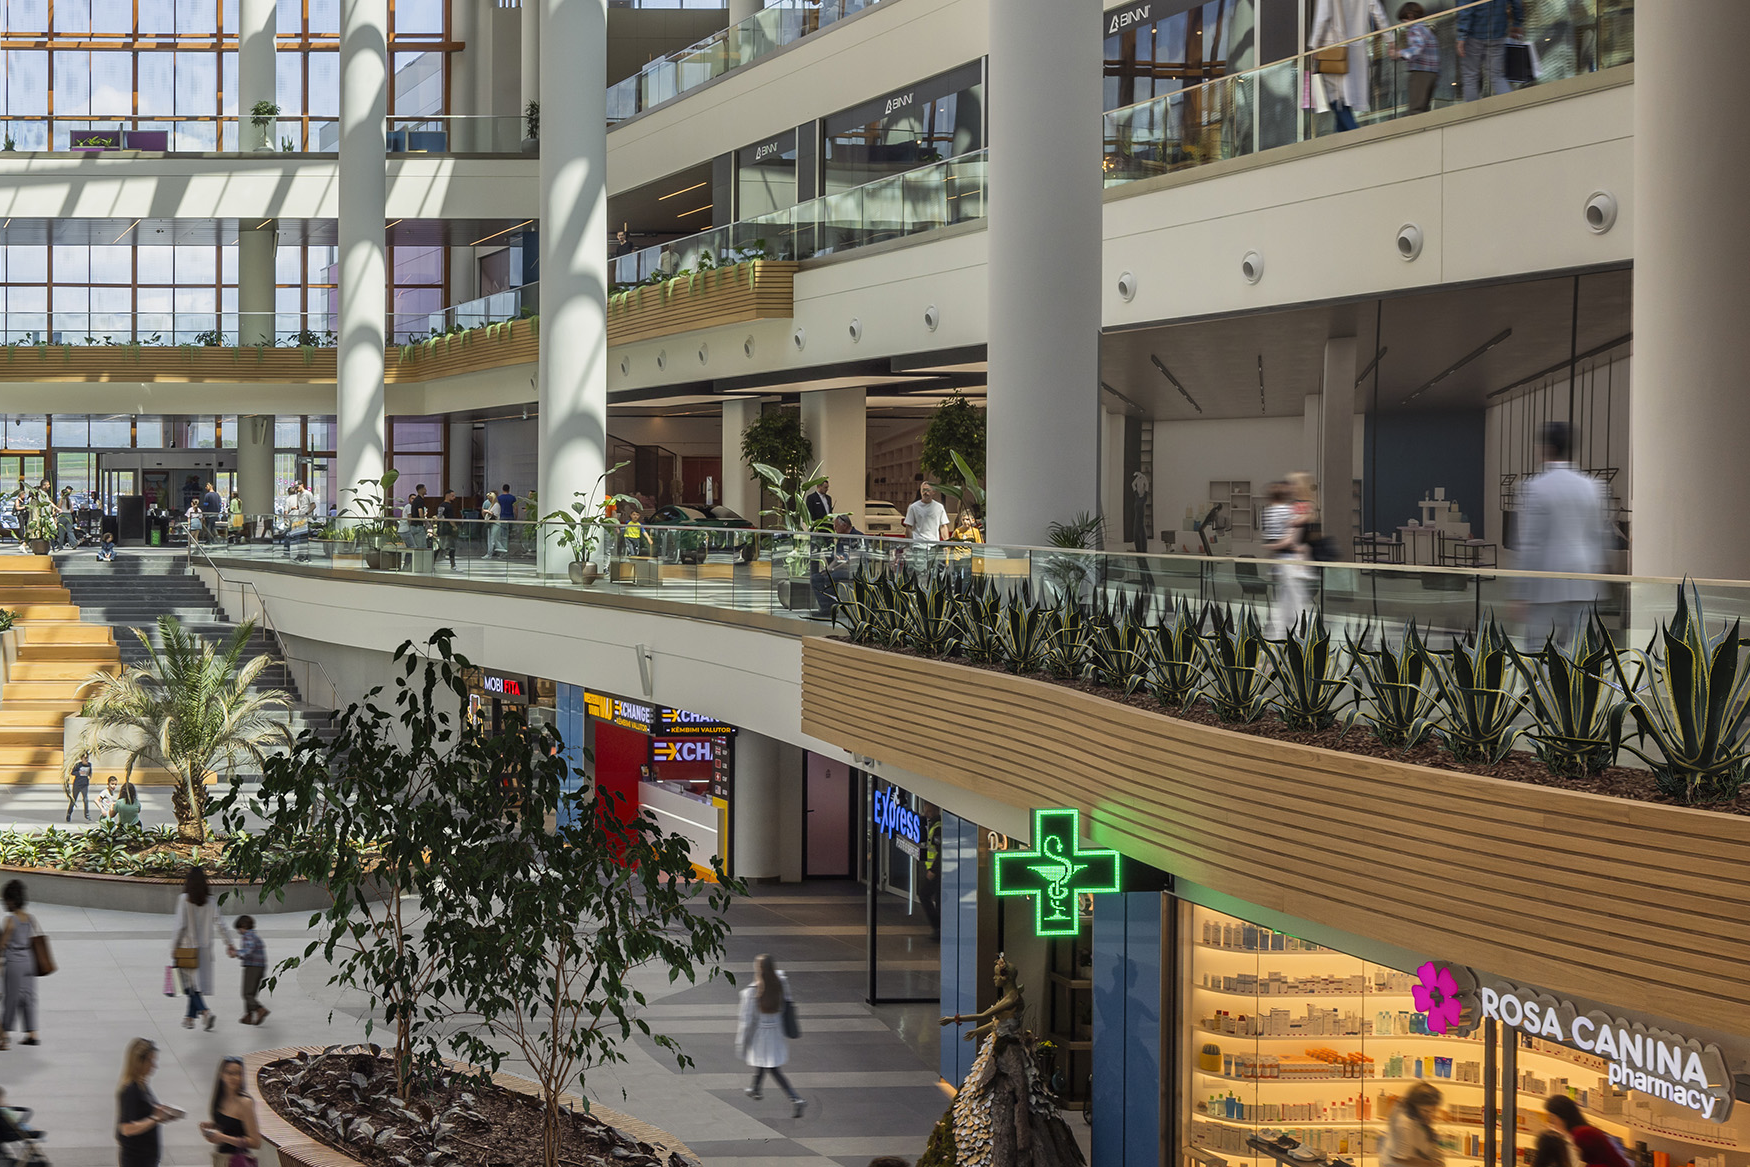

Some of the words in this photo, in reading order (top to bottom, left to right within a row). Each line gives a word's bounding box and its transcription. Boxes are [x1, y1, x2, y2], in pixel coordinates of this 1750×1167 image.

[1120, 5, 1149, 27] BINNI
[484, 675, 503, 693] MOBI
[504, 679, 521, 696] FITA
[614, 699, 650, 724] EXCHANGE
[670, 726, 700, 734] KËMBIMI
[701, 726, 731, 734] VALUTOR
[653, 742, 713, 761] EXCH
[1482, 987, 1564, 1041] ROSA
[1571, 1016, 1709, 1089] CANINA
[1608, 1061, 1716, 1119] pharmacy
